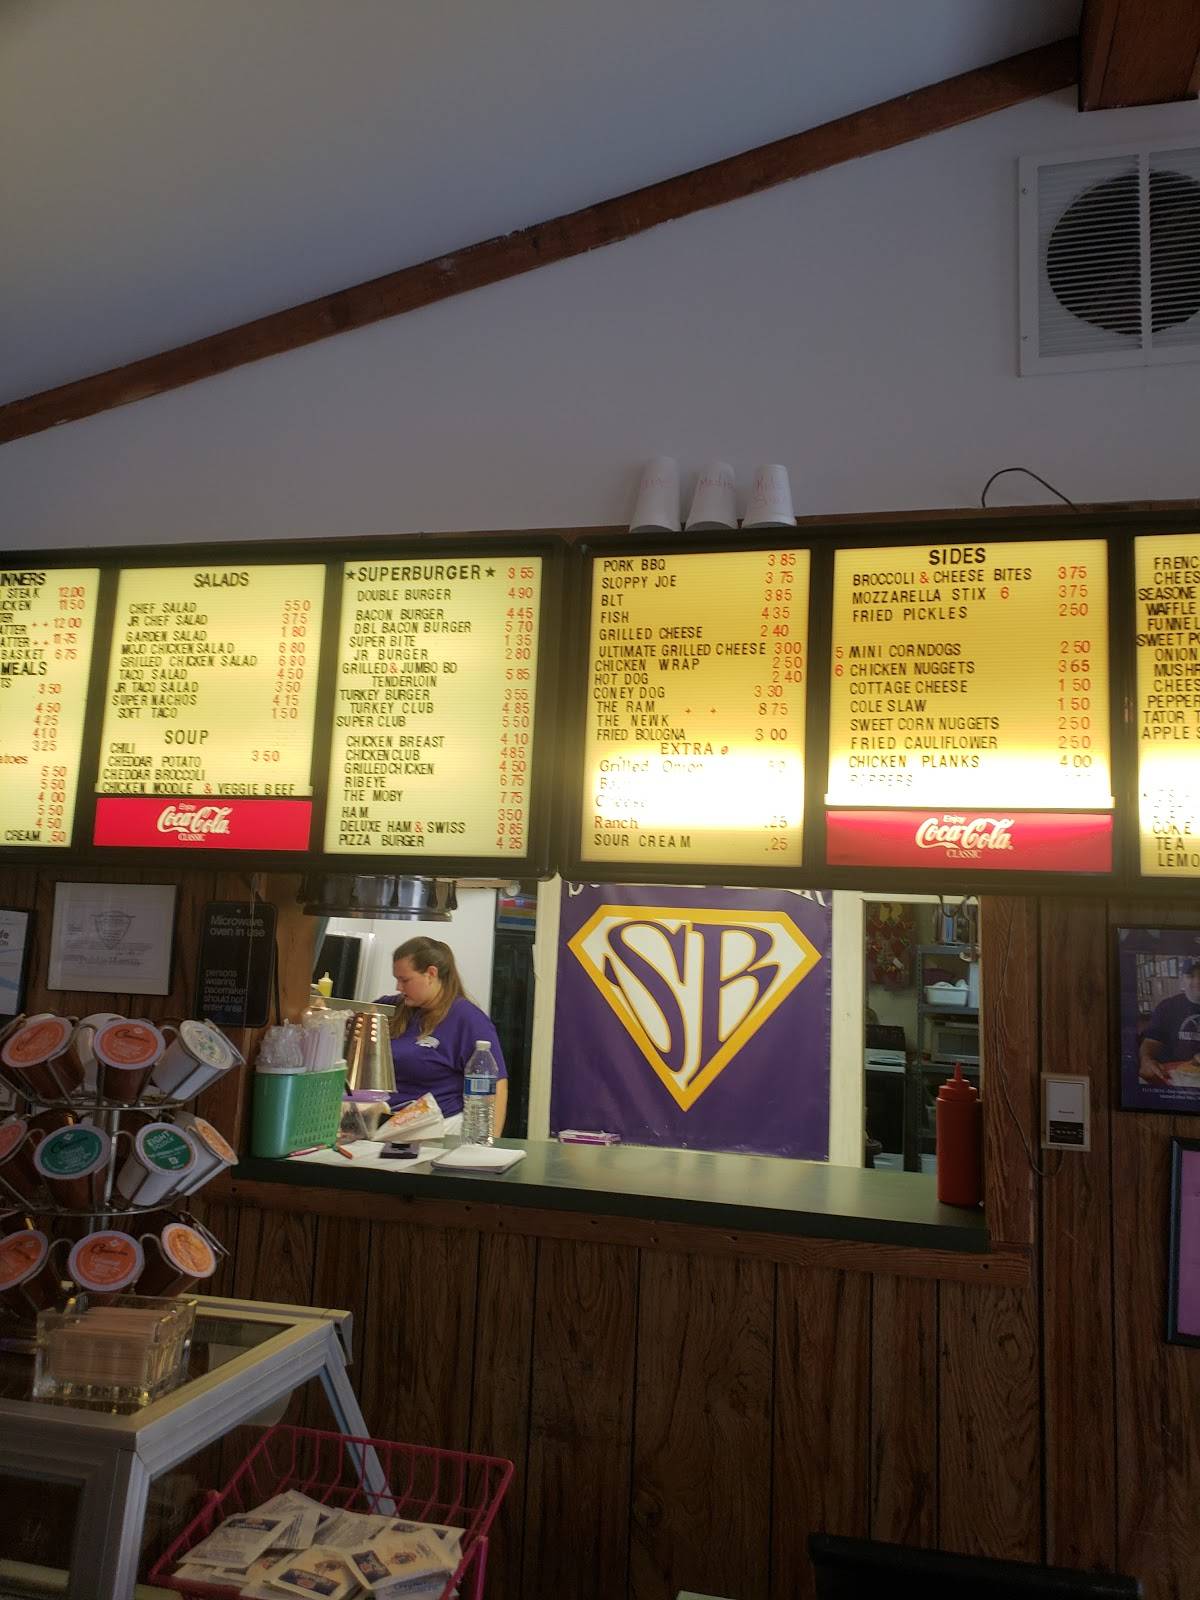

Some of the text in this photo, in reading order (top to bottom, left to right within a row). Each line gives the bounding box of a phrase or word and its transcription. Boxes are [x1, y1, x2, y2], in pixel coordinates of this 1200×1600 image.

[930, 548, 986, 565] SIDES
[604, 559, 666, 572] PORK BBQ
[358, 565, 481, 581] SUPERBURGER
[853, 572, 915, 586] BROCCOLI
[920, 571, 929, 584] &
[934, 570, 984, 583] CHEESE
[994, 568, 1032, 581] BITES
[194, 572, 249, 588] SALADS
[602, 576, 676, 589] SLOPPY JOE
[358, 588, 451, 601] DOUBLE BURGER
[602, 594, 624, 606] BLT
[853, 589, 941, 604] MOZZARELLA
[952, 588, 986, 600] STIX
[1000, 586, 1008, 599] 6
[129, 602, 197, 614] CHEF SALAD
[1146, 602, 1196, 615] WAFFLE
[128, 614, 208, 626] JR CHEF SALAD
[356, 609, 444, 620] BACON BURGER
[600, 612, 629, 623] FISH
[853, 609, 892, 622] FRIED
[904, 607, 967, 620] PICKLES
[354, 622, 472, 634] DBL BACON BURGER
[600, 627, 703, 640] GRILLED CHEESE
[126, 630, 207, 642] GARDEN SALAD
[349, 636, 416, 647] SUPER BITE
[1136, 633, 1183, 646] SWEET
[152, 643, 234, 654] CHICKEN SALAD
[600, 643, 766, 658] ULTIMATE GRILLED CHEESE
[836, 643, 960, 658] 5 MINI CORNDOGS
[1154, 648, 1198, 661] ONION
[354, 650, 428, 660] JR BURGER
[120, 656, 258, 668] GRILLED CHICKEN SALAD
[595, 660, 700, 672] CHICKEN WRAP
[120, 669, 187, 680] TACO SALAD
[343, 663, 388, 674] GRILLED
[401, 663, 438, 674] JUMBO
[835, 662, 975, 676] 6 CHICKEN NUGGETS
[372, 676, 437, 687] TENDERLOIN
[594, 674, 648, 684] HOT DOG
[114, 682, 199, 692] JR TACO SALAD
[594, 687, 665, 698] CONEY DOG
[850, 680, 968, 695] COTTAGE CHEESE
[112, 695, 197, 706] SUPER NACHOS
[340, 690, 430, 700] TURKEY BURGER
[350, 702, 434, 713] TURKEY CLUB
[597, 702, 655, 712] THE RAM
[851, 700, 926, 712] COLE SLAW
[118, 708, 177, 718] SOFT TACO
[1143, 711, 1184, 723] TATOR
[336, 716, 406, 727] SUPER CLUB
[597, 715, 668, 726] THE NEWK
[851, 718, 893, 731] SWEET
[898, 718, 934, 730] CORN
[939, 717, 1000, 730] NUGGETS
[165, 730, 208, 744] SOUP
[597, 729, 686, 740] FRIED BOLOGNA
[1142, 726, 1190, 739] APPLE
[346, 736, 445, 748] CHICKEN BREAST
[851, 737, 998, 750] FRIED CAULIFLOWER
[110, 744, 134, 753] CHILI
[660, 743, 714, 755] EXTRA
[346, 750, 420, 760] CHICKEN CLUB
[108, 756, 202, 767] CHEDDAR POTATO
[849, 756, 980, 768] CHICKEN PLANKS
[104, 770, 205, 780] CHEDDAR BROCCOLI
[344, 764, 434, 774] GRILLED CHICKEN
[102, 782, 295, 794] CHICKEN NOODLE & VEGGIE BEEF
[345, 777, 386, 788] RIBEYE
[344, 790, 403, 801] THE MOBY
[342, 807, 368, 818] HAM
[340, 821, 464, 833] DELUXE HAM & SWISS
[594, 816, 639, 829] Ranch
[5, 830, 40, 842] CREAM
[340, 835, 424, 846] PIZZA BURGER
[594, 834, 690, 848] SOUR CREAM
[1156, 837, 1184, 850] TEA
[210, 916, 264, 926] Microwave
[210, 926, 265, 936] oven in use
